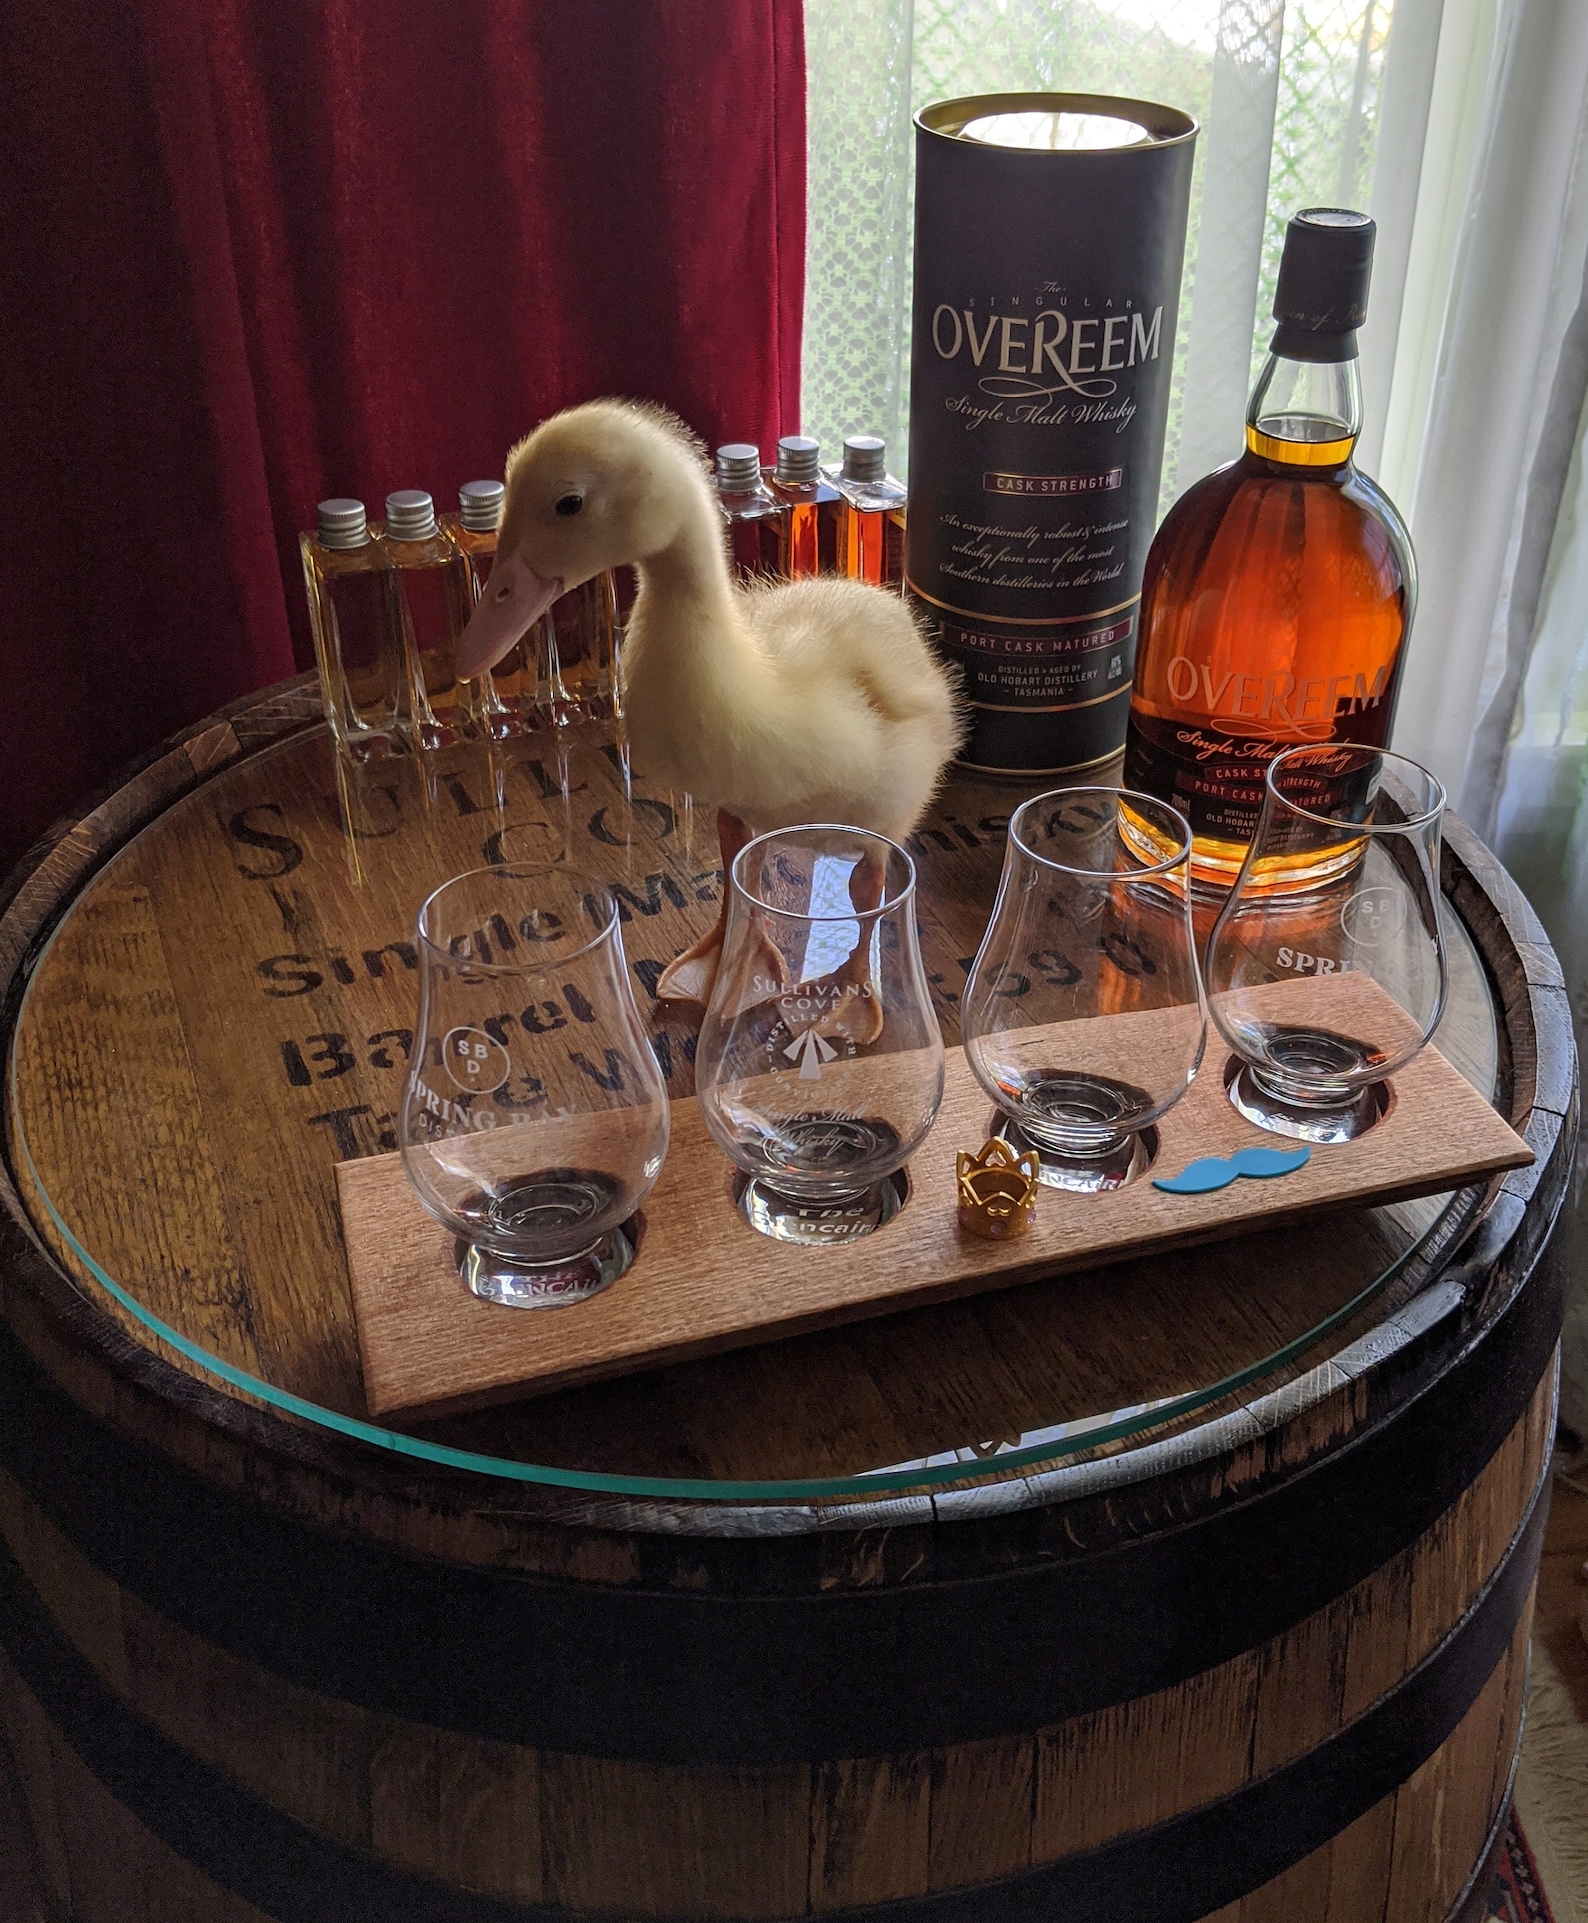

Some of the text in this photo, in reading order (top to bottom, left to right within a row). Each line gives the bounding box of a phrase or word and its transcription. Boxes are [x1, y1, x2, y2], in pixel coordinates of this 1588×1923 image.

[969, 296, 1132, 309] SINGULAR
[932, 304, 1163, 388] OVEREEM
[945, 396, 1137, 433] Single Malt Whisky
[996, 476, 1114, 492] CASK STRENGTH
[940, 513, 960, 528] An
[962, 523, 1041, 549] exceptionally
[1043, 522, 1081, 540] robust
[1093, 519, 1129, 535] intense
[951, 540, 1115, 573] whisky from one of the most
[939, 563, 990, 584] Southern
[992, 574, 1053, 589] distilleries
[1056, 578, 1072, 588] in
[1072, 568, 1092, 587] the
[960, 630, 1115, 652] PORT CASK MATURED
[977, 672, 997, 684] OLD
[1000, 675, 1040, 685] HOBART
[1044, 669, 1098, 685] DISTILLERY
[998, 665, 1039, 675] DISTILLED
[1014, 687, 1065, 697] TASMANIA
[1166, 655, 1388, 734] OVEREEM
[1176, 731, 1234, 760] Single
[1216, 768, 1249, 779] CASK
[1195, 780, 1264, 802] PORT CASK
[228, 740, 646, 882] SULLI
[1206, 813, 1256, 828] OLD HOBAR
[481, 798, 682, 880] CO
[1276, 946, 1362, 979] SPRI
[753, 975, 874, 999] SULLIVANS
[780, 997, 841, 1012] COVE
